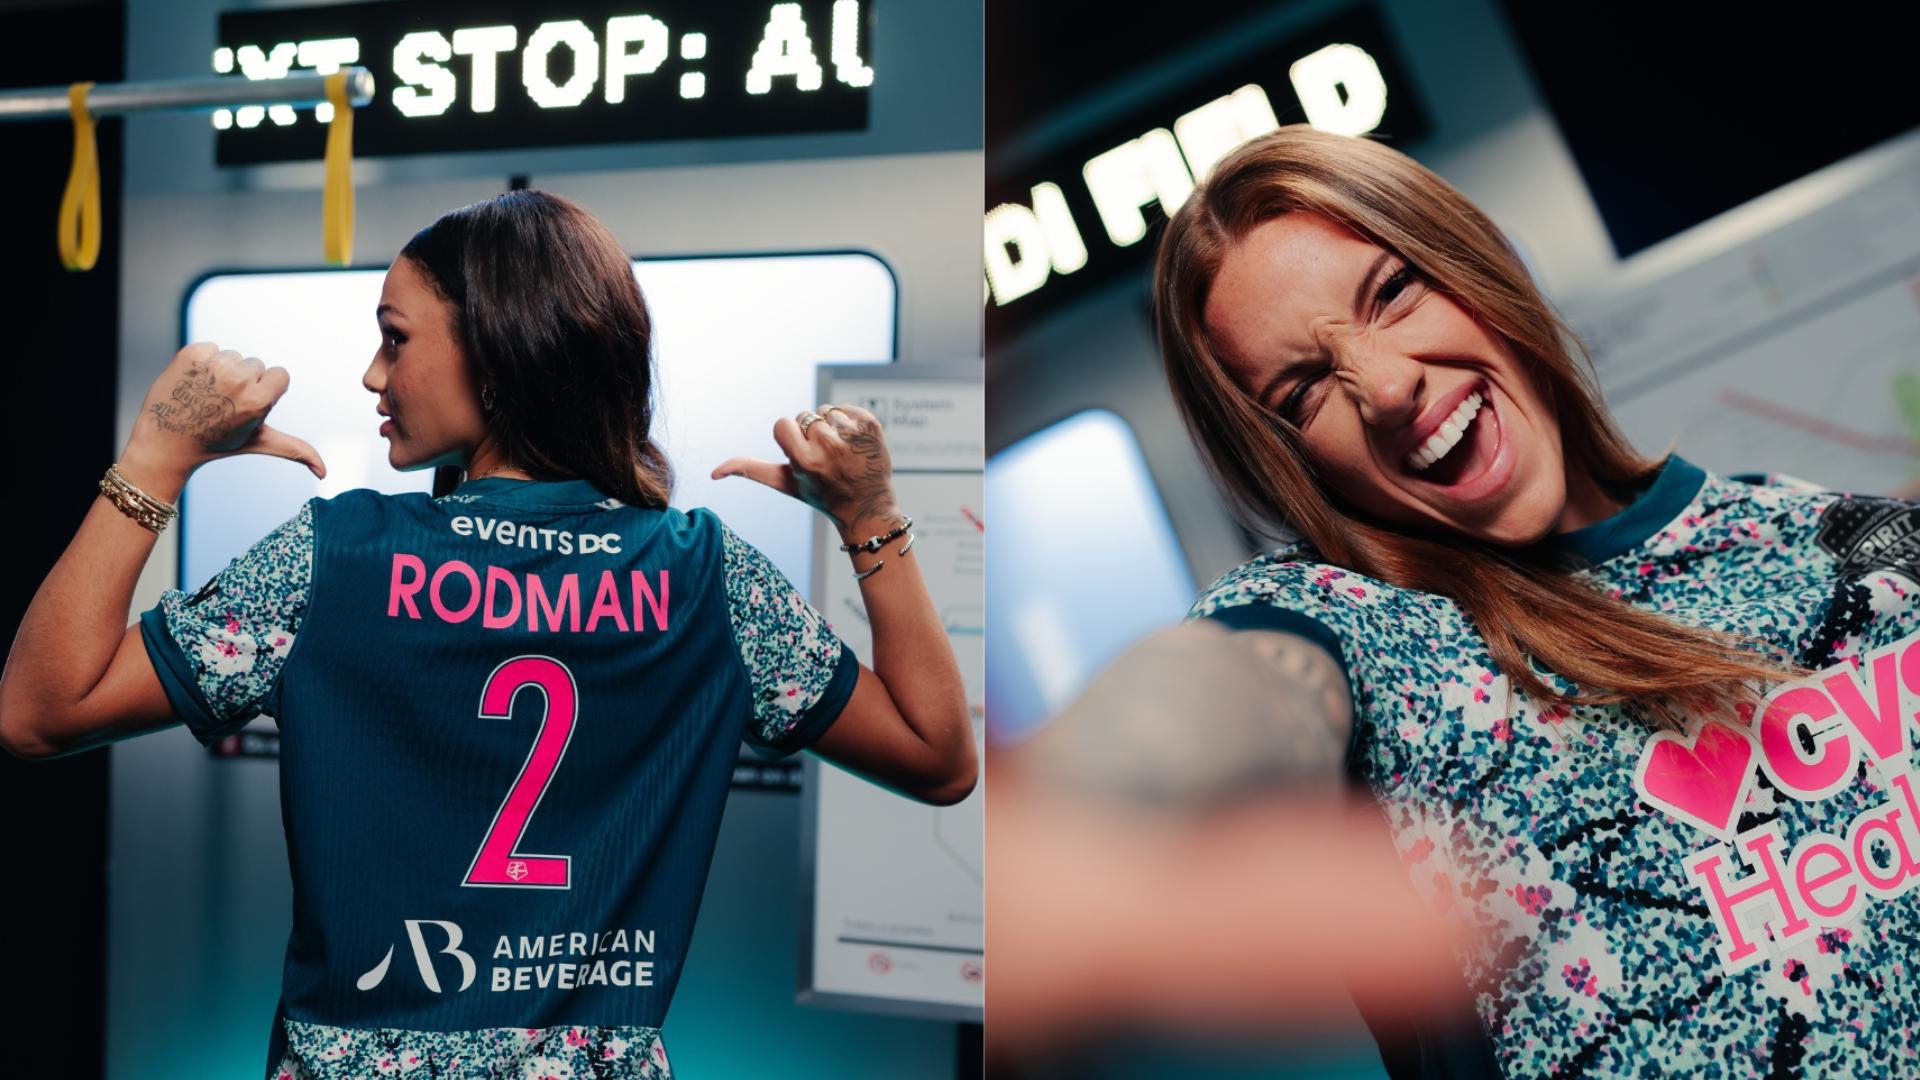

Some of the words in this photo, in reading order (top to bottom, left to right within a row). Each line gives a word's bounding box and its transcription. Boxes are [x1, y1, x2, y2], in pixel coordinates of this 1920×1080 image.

[213, 38, 360, 130] XT
[393, 15, 707, 117] STOP:
[1851, 512, 1914, 565] SPIRIT
[387, 553, 669, 632] RODMAN
[460, 654, 579, 889] 2
[491, 959, 654, 992] BEVERAGE
[493, 929, 655, 960] AMERICAN
